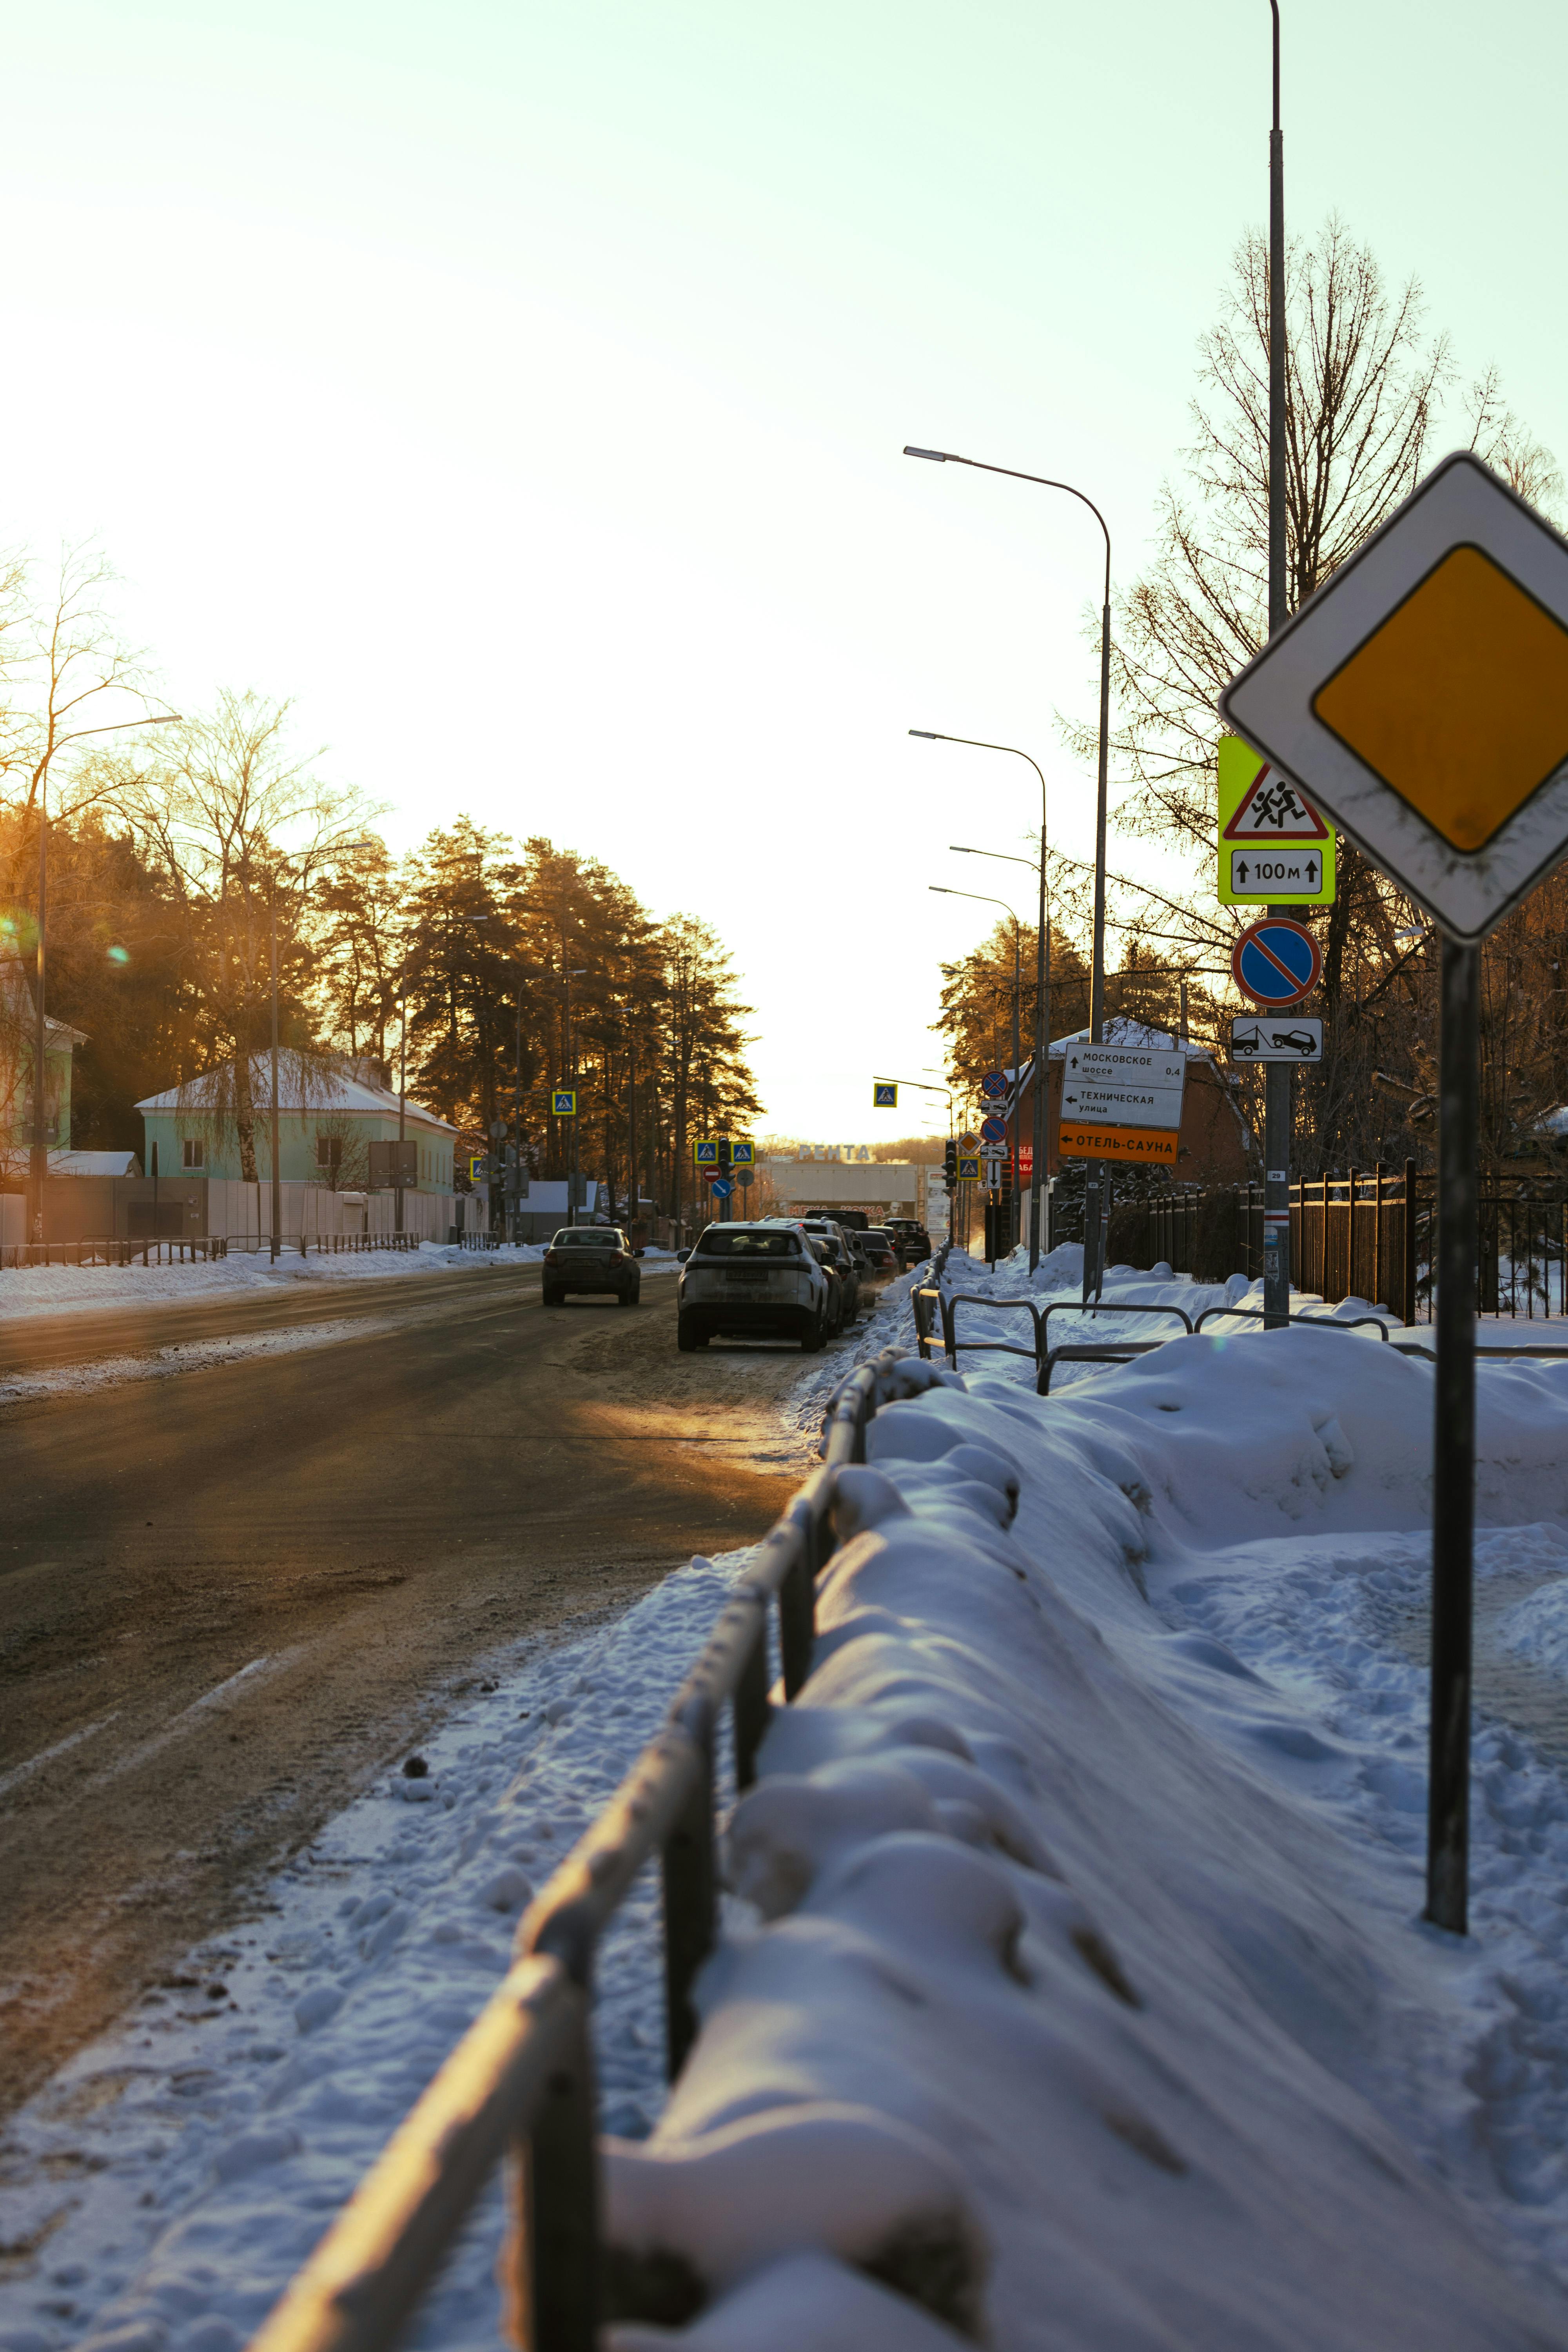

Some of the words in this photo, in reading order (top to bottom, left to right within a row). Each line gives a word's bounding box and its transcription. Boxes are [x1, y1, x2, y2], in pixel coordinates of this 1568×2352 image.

[1083, 1053, 1152, 1065] МОСКОВСКОЕ
[1166, 1067, 1180, 1076] 0,4
[1080, 1091, 1154, 1104] ТЕХНИЧЕСКАЯ
[1076, 1135, 1173, 1153] ОТЕЛЬ-САУНА
[799, 1145, 870, 1160] РЕНТА
